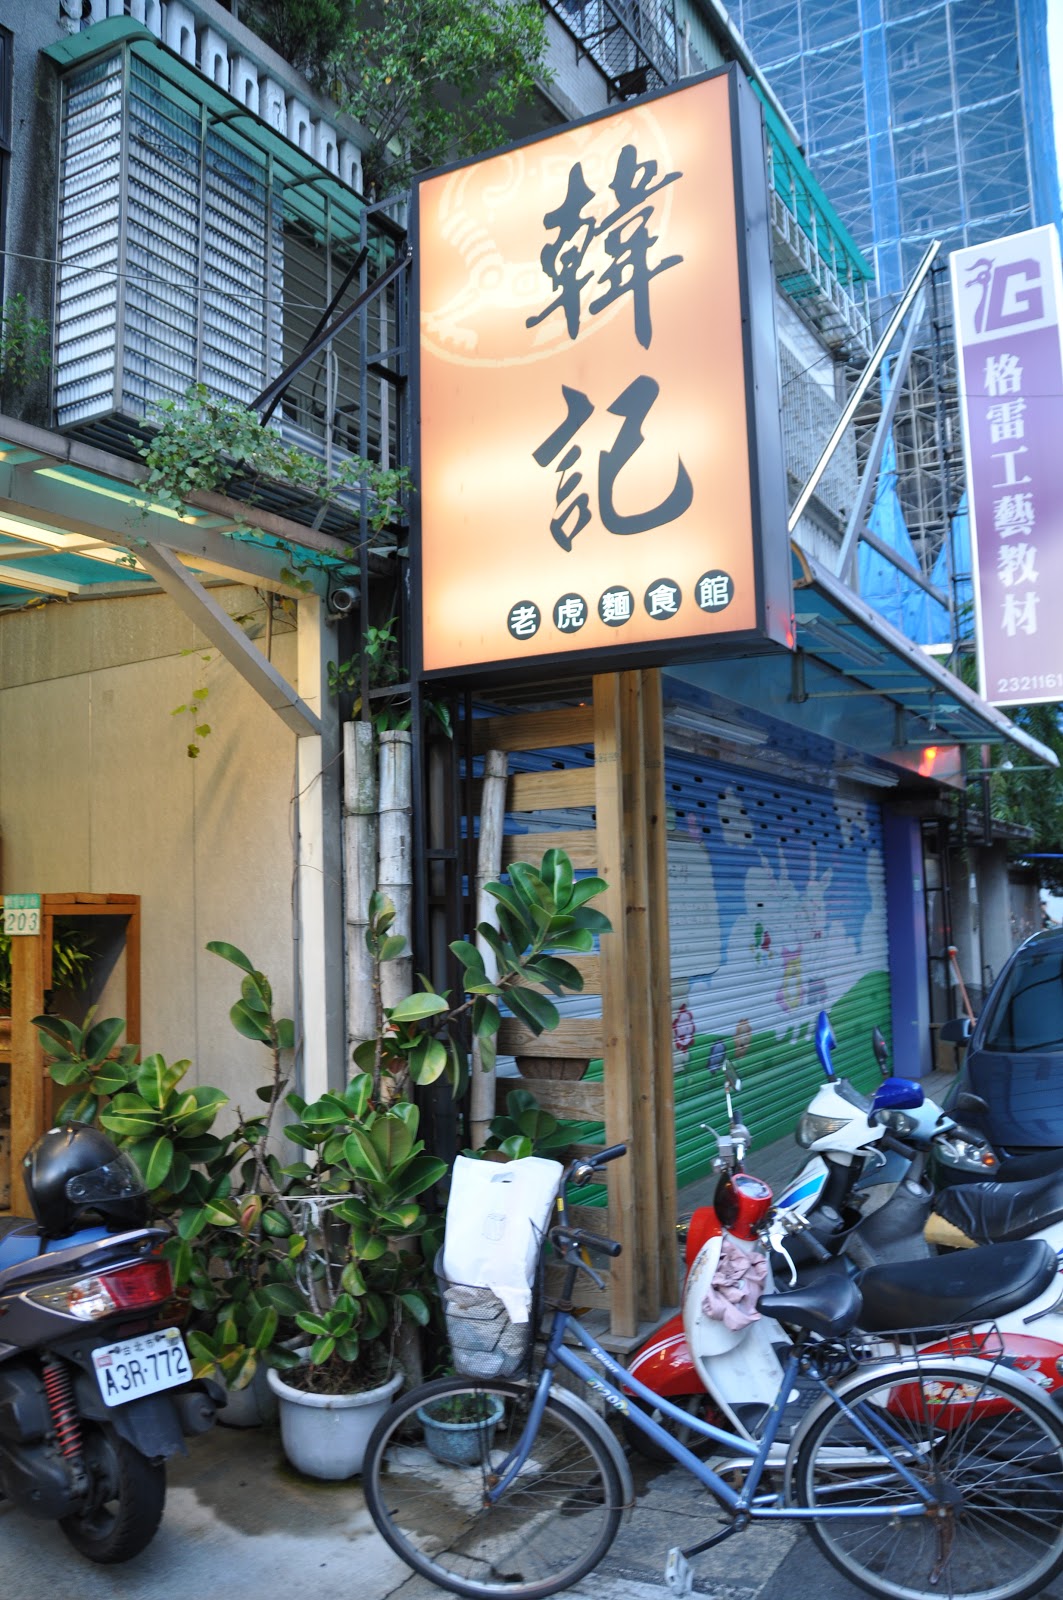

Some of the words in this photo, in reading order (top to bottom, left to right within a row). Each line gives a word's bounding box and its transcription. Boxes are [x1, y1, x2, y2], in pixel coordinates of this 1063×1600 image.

[526, 143, 694, 553] 韓記
[983, 353, 1041, 637] 格雷工藝教材
[510, 574, 730, 636] 老虎麵食館
[997, 673, 1063, 693] 2321161
[8, 912, 38, 931] 203
